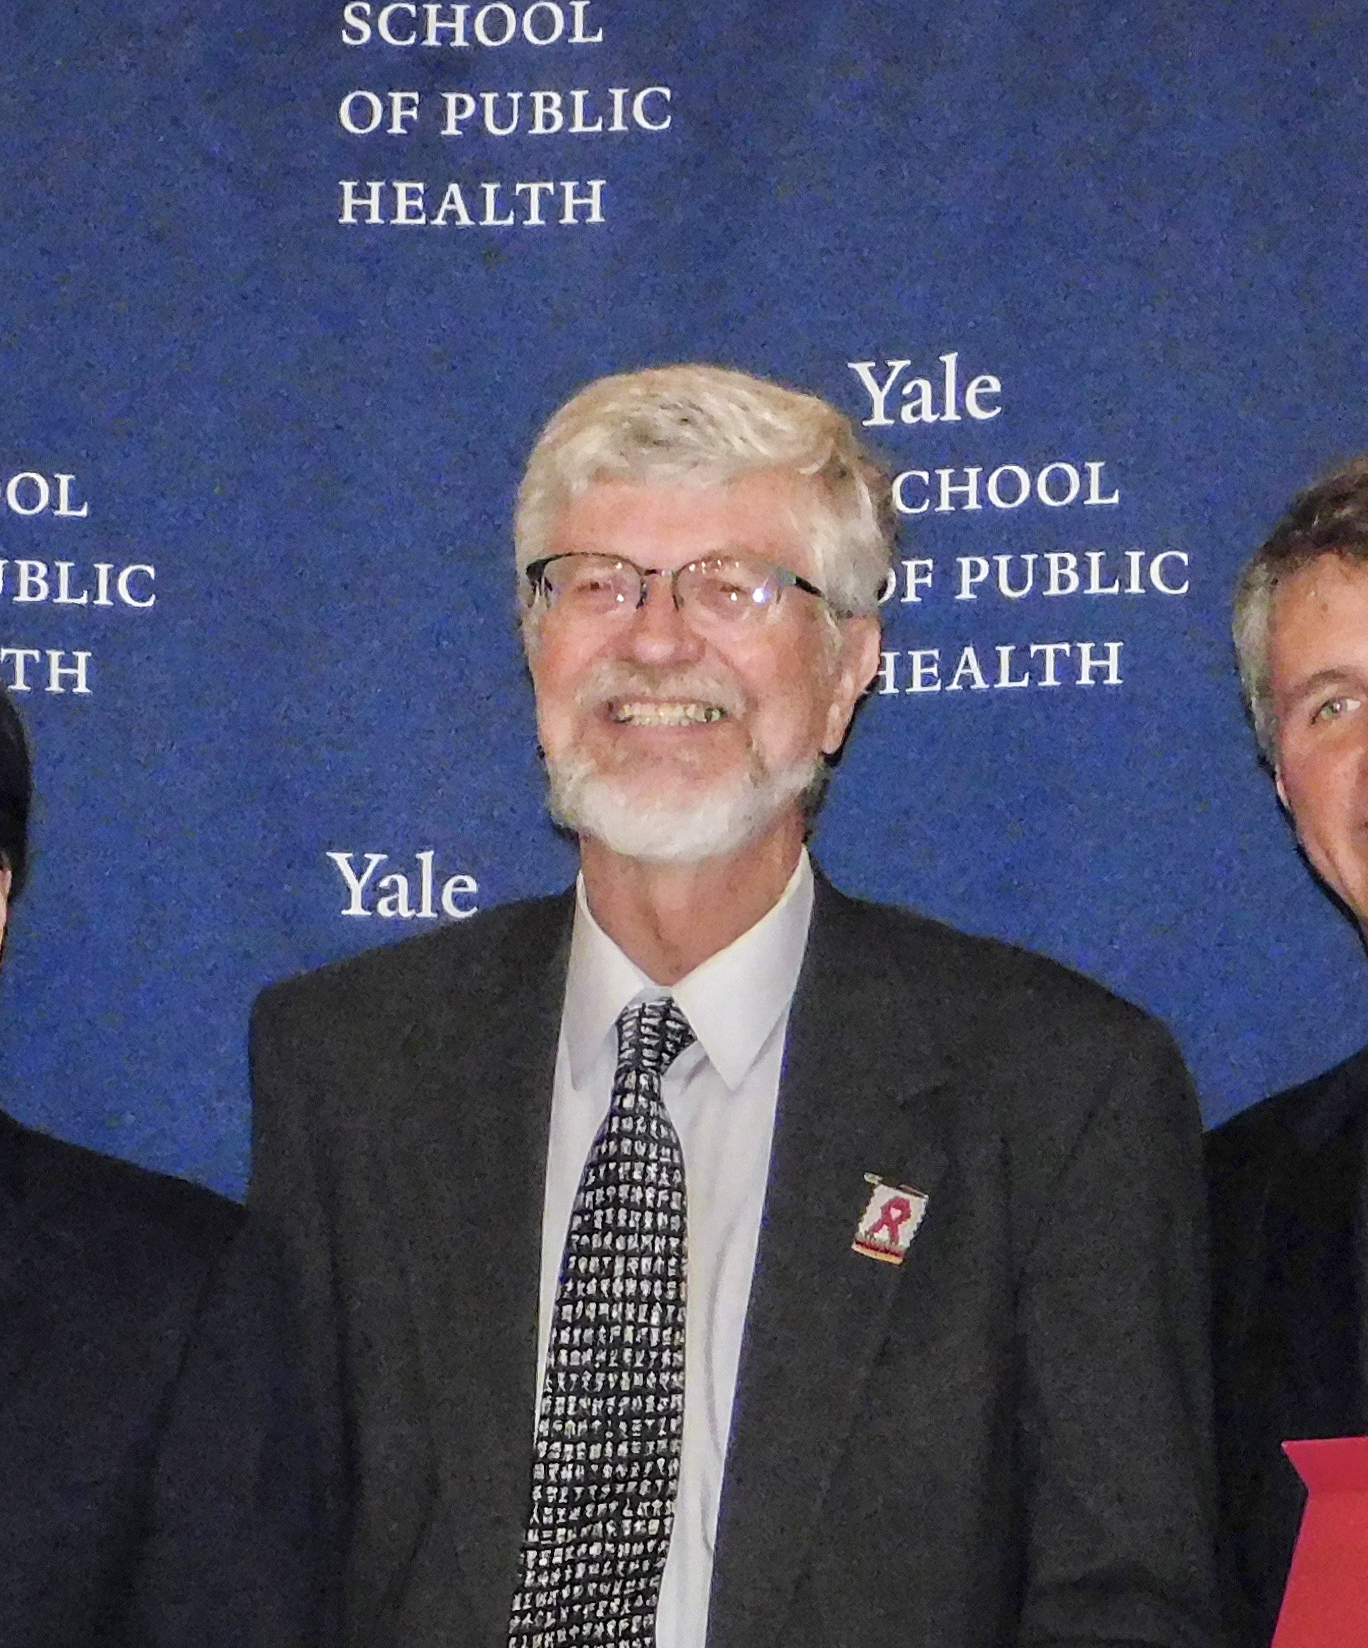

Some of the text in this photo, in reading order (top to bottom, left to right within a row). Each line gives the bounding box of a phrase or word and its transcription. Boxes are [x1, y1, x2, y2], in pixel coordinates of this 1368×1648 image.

[340, 0, 604, 48] SCHOOL
[337, 85, 673, 137] OF PUBLIC
[337, 178, 608, 228] HEALTH
[846, 350, 1003, 428] Yale
[890, 460, 1121, 516] CHOOL
[953, 549, 1191, 602] PUBLIC
[324, 848, 480, 918] Yale
